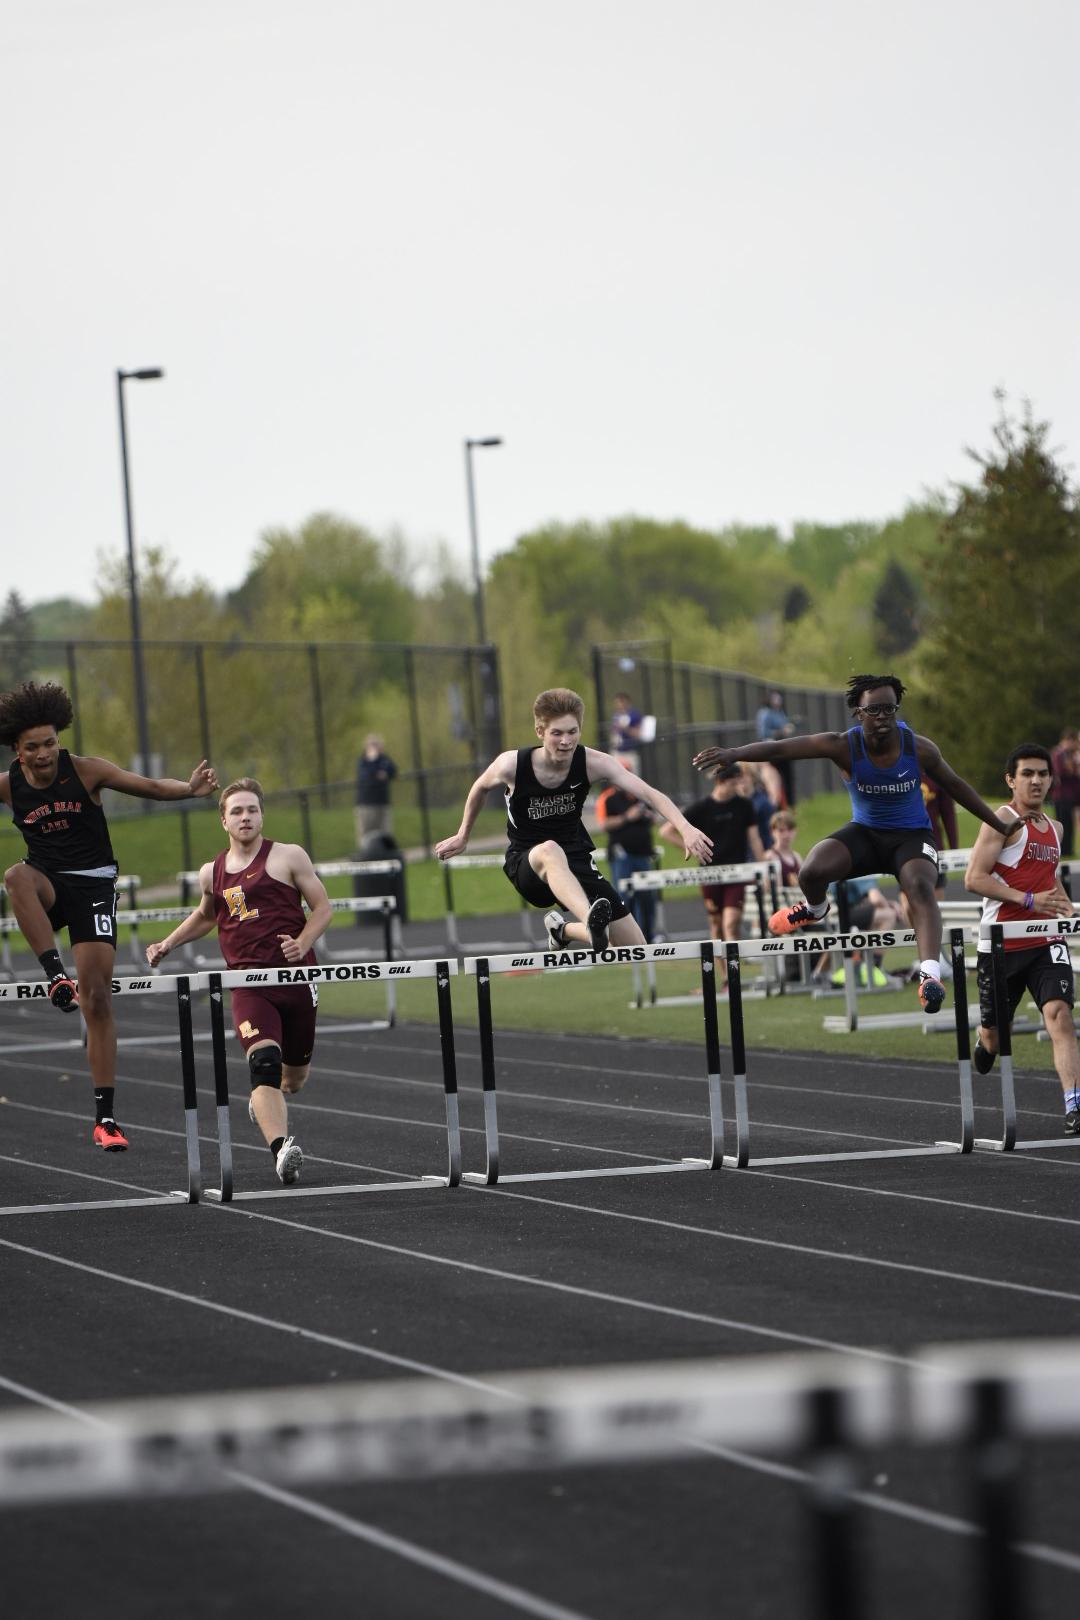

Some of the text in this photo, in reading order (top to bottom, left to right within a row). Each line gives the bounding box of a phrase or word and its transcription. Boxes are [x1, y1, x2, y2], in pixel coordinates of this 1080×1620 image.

[857, 779, 917, 794] WOODBURY
[54, 801, 82, 813] BEAR
[530, 793, 576, 808] EAST
[528, 802, 576, 820] RIDGE
[98, 914, 111, 934] 6
[1026, 924, 1049, 933] GILL
[762, 943, 785, 952] GILL
[794, 933, 896, 952] RAPTORS
[511, 947, 676, 967] GILL RAPTORS GILL
[1053, 944, 1066, 963] 2
[245, 965, 412, 983] GILL RAPTORS GILL
[129, 981, 153, 990] GILL
